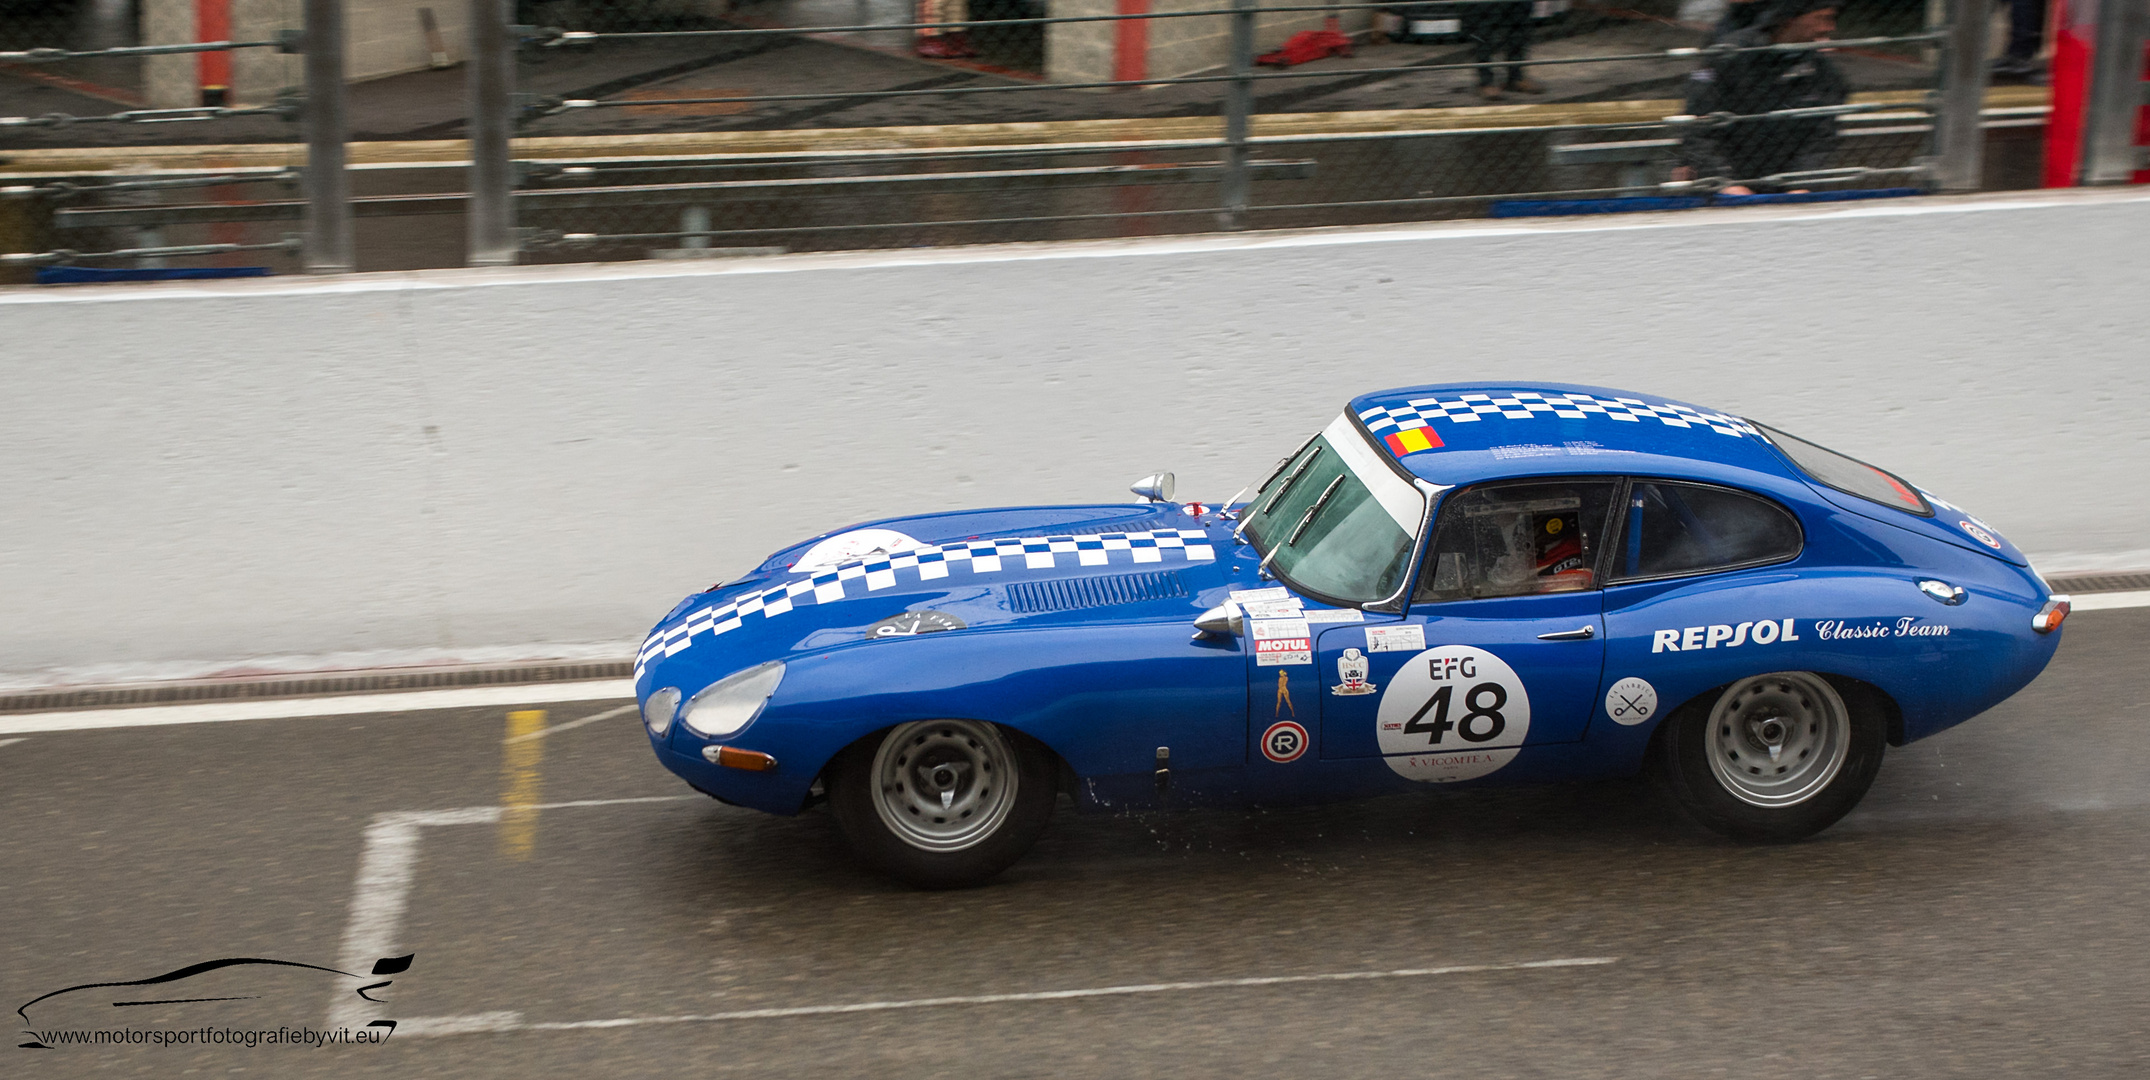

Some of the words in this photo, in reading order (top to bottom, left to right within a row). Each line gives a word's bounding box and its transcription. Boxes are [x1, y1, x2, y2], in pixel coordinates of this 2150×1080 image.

[1651, 618, 1799, 653] REPSOL
[1815, 619, 1891, 640] Classic
[1894, 616, 1951, 637] Team
[1258, 639, 1309, 652] MOTUL
[1342, 661, 1365, 669] HSCC
[1429, 657, 1477, 680] EFG
[1403, 682, 1508, 744] 48
[1421, 755, 1480, 767] VICOMTE
